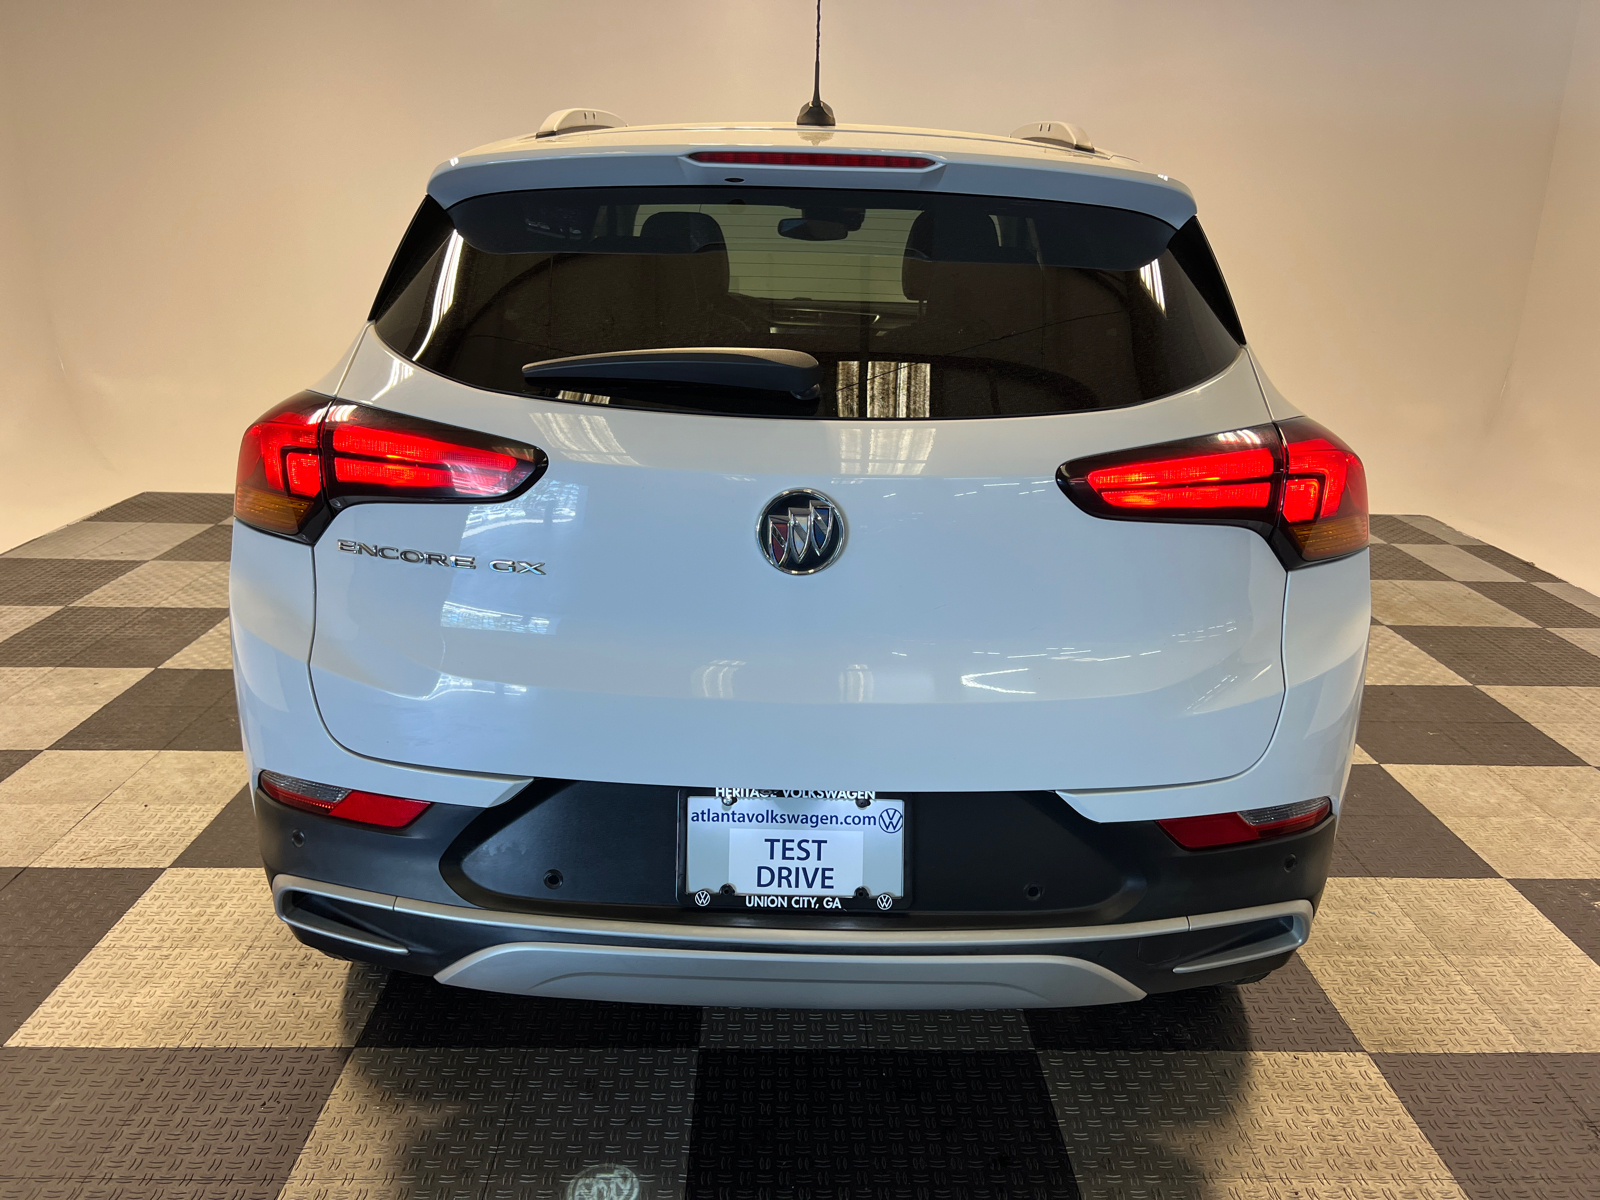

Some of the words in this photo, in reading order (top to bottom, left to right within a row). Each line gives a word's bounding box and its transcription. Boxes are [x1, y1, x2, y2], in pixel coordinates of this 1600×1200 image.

[337, 539, 477, 570] ENCORE
[488, 559, 547, 576] GX
[783, 789, 876, 800] VOLKSWAGEN
[691, 808, 877, 828] atlantavolkswagen.com
[764, 838, 828, 862] TEST
[756, 865, 834, 889] DRIVE
[745, 895, 788, 909] UNION
[791, 896, 819, 910] CITY,
[823, 897, 842, 909] GA
